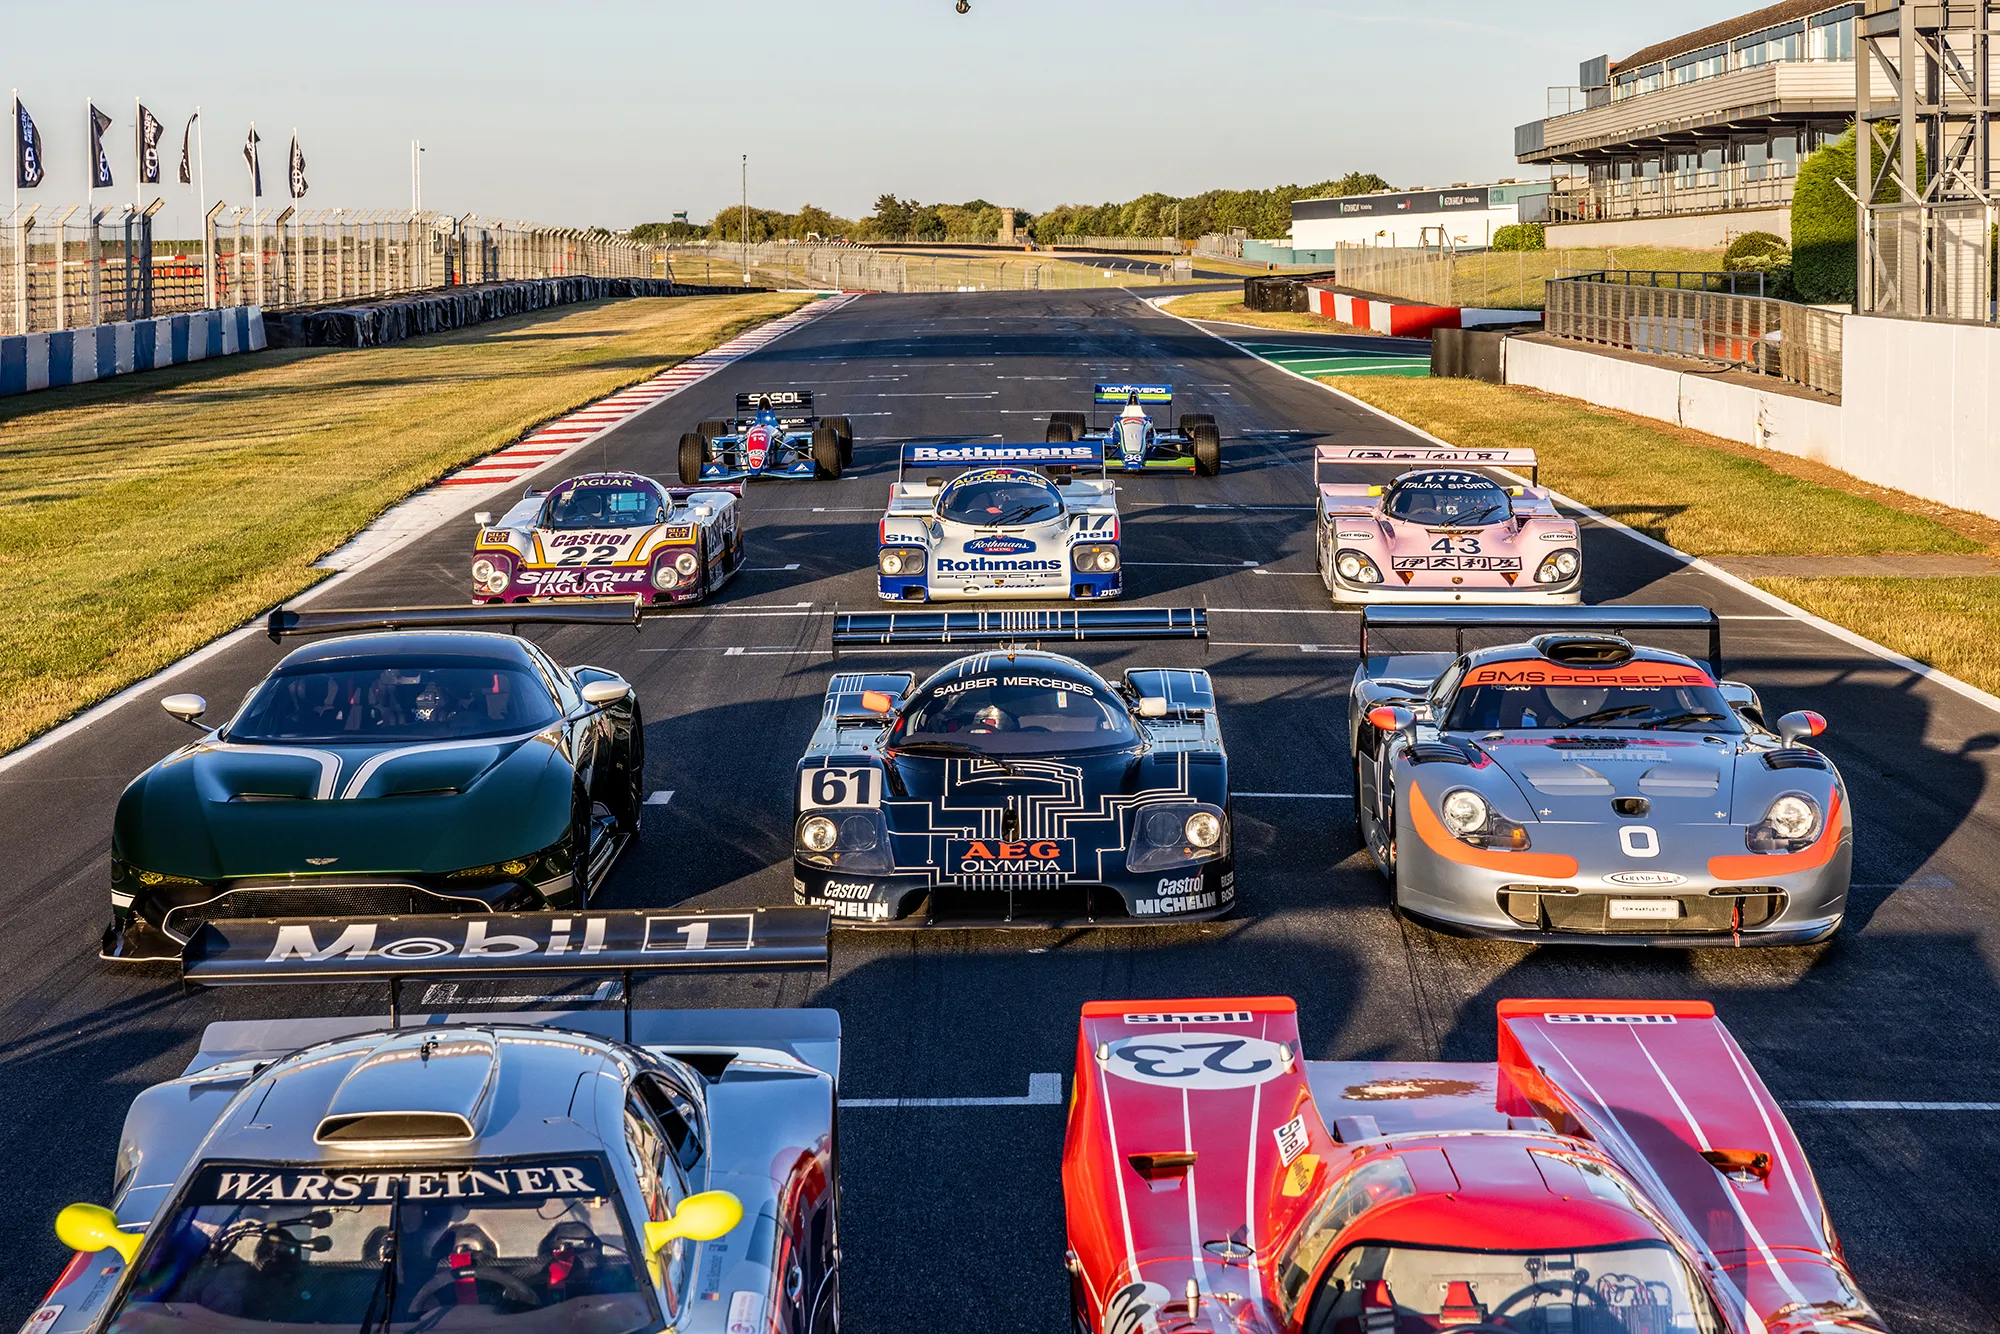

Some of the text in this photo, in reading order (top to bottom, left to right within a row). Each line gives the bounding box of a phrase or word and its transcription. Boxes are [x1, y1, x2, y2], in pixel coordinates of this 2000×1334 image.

[145, 148, 158, 178] SCD
[914, 447, 1093, 460] Rothmans
[570, 479, 633, 490] JAGUAR
[953, 472, 1048, 488] AUTOGLASS
[550, 533, 631, 548] Castrol
[970, 540, 1030, 550] Rothmans
[1431, 537, 1483, 555] 43
[556, 546, 619, 566] 22
[937, 557, 1062, 572] Rothmans
[516, 569, 647, 584] Silk Cut
[532, 582, 616, 597] JAGUAR
[1478, 671, 1703, 684] BMS PORSCHE
[933, 676, 1094, 698] SAUBER MERCEDES
[811, 769, 871, 806] 61
[961, 841, 1060, 859] AEG
[1617, 825, 1661, 858] 0
[960, 860, 1061, 872] OLYMPIA
[824, 880, 874, 899] Castrol
[1157, 874, 1204, 896] Castrol
[1135, 891, 1217, 914] MICHELIN
[265, 918, 716, 963] Mobil 1
[1127, 1012, 1249, 1022] Shell
[1548, 1014, 1673, 1023] Shell
[1116, 1039, 1273, 1078] 23
[1279, 1118, 1305, 1163] Shell
[216, 1166, 596, 1201] WARSTEINER
